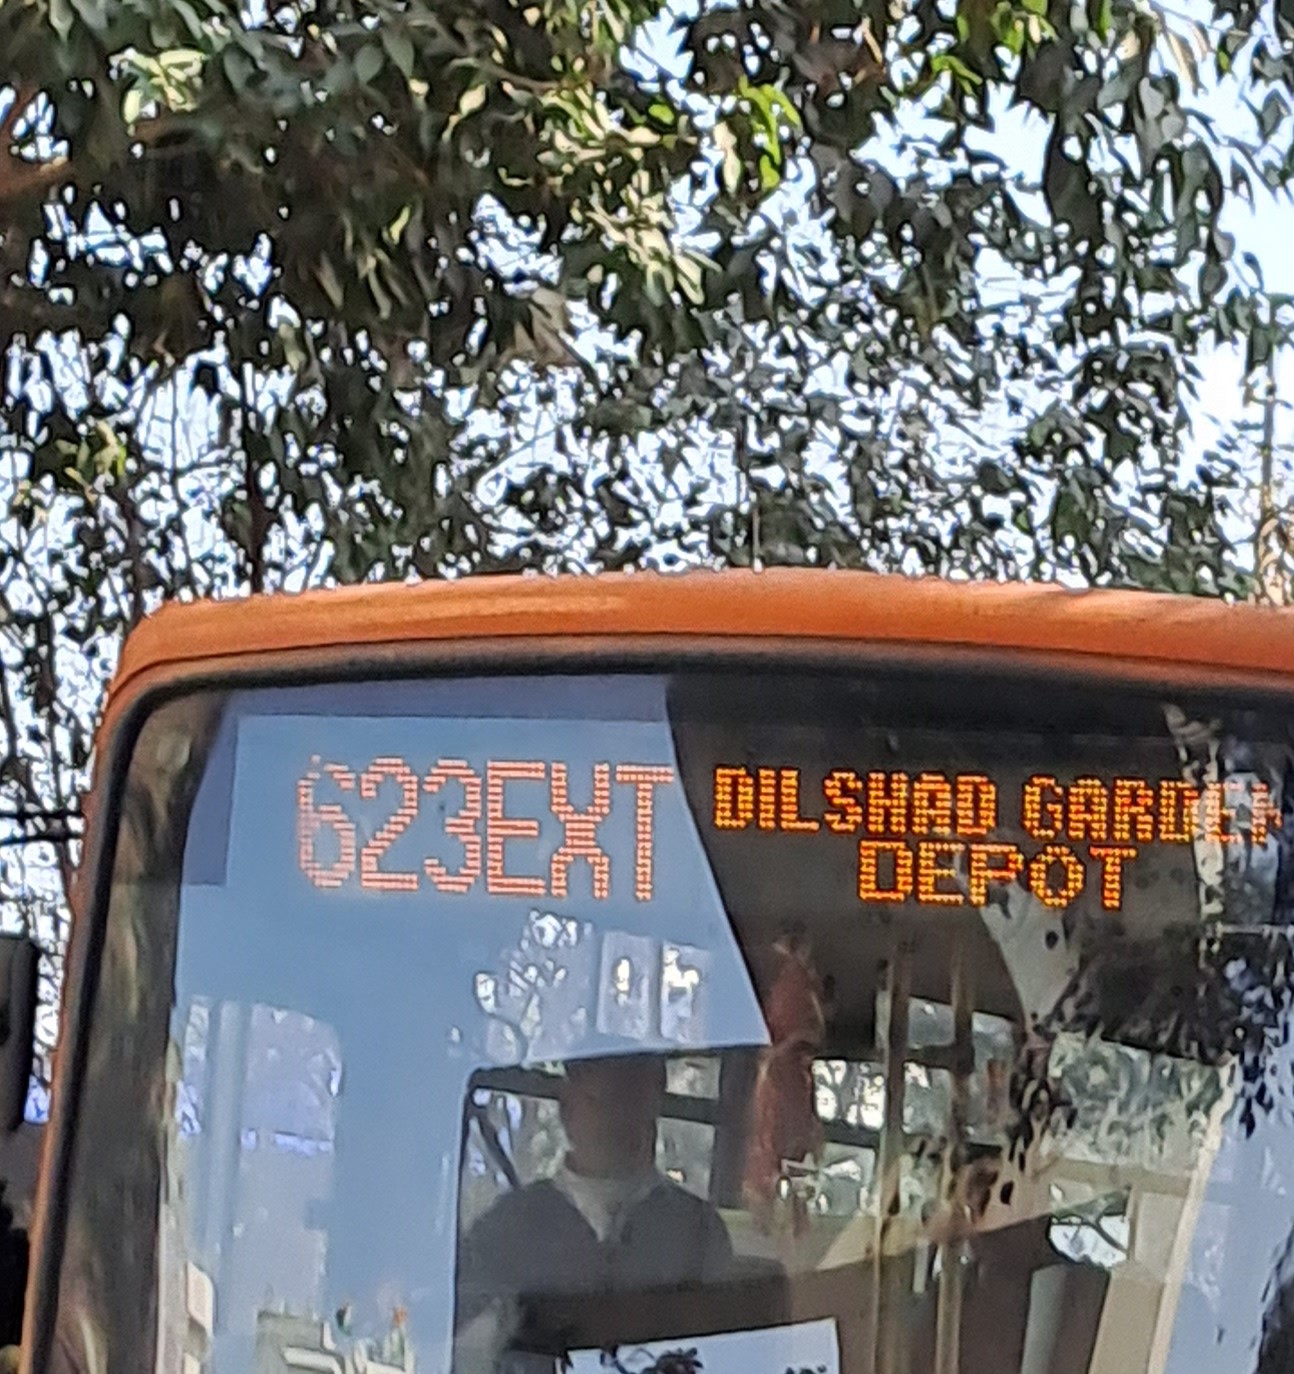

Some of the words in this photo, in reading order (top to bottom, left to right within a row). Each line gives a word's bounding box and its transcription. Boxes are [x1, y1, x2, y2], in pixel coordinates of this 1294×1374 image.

[297, 754, 674, 902] 623EXT
[714, 766, 997, 836] DILSHAD
[858, 839, 1138, 911] DEPOT
